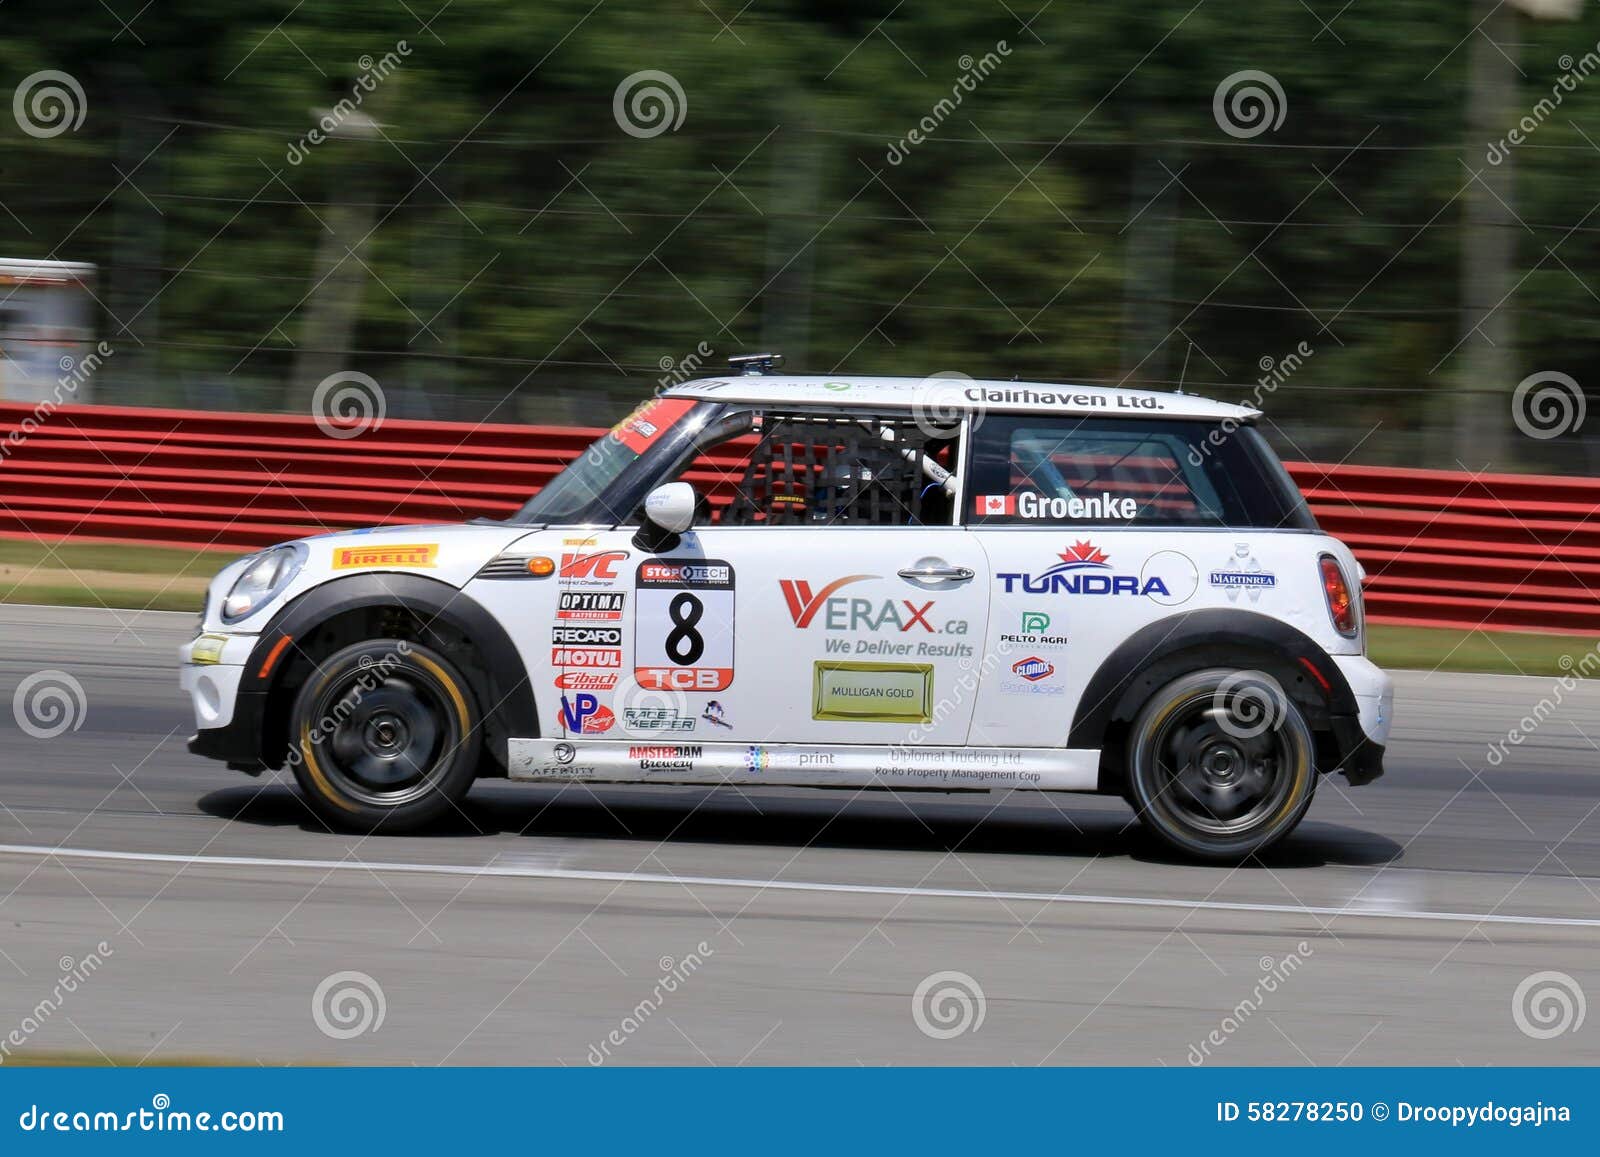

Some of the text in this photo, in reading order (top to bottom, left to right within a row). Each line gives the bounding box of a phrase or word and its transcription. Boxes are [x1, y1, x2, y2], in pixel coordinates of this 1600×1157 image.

[964, 388, 1165, 410] Clairhaven Ltd.
[1018, 492, 1137, 519] Groenke
[341, 547, 430, 565] PIRELLI
[559, 551, 630, 579] WC
[996, 573, 1171, 596] TUNDRA
[1213, 573, 1274, 586] MARTINREA
[561, 594, 622, 610] OPTIMA
[553, 629, 620, 644] RECARO
[665, 592, 704, 666] 8
[1000, 634, 1068, 645] PELTO AGRI
[825, 639, 973, 657] We Deliver Results
[554, 650, 620, 666] MOTUL
[1016, 662, 1050, 676] CLOROX
[556, 672, 619, 687] Eibach
[648, 669, 720, 689] TCB
[831, 686, 914, 699] MULLIGAN GOLD
[560, 693, 599, 734] VP
[627, 719, 694, 729] KEEPER
[628, 746, 702, 758] AMSTERDAM
[799, 751, 835, 766] print
[891, 750, 1024, 766] Diplomat Trucking Ltd.
[639, 758, 693, 771] Brewery
[875, 766, 1041, 782] Ro-Ro Property Management Corp
